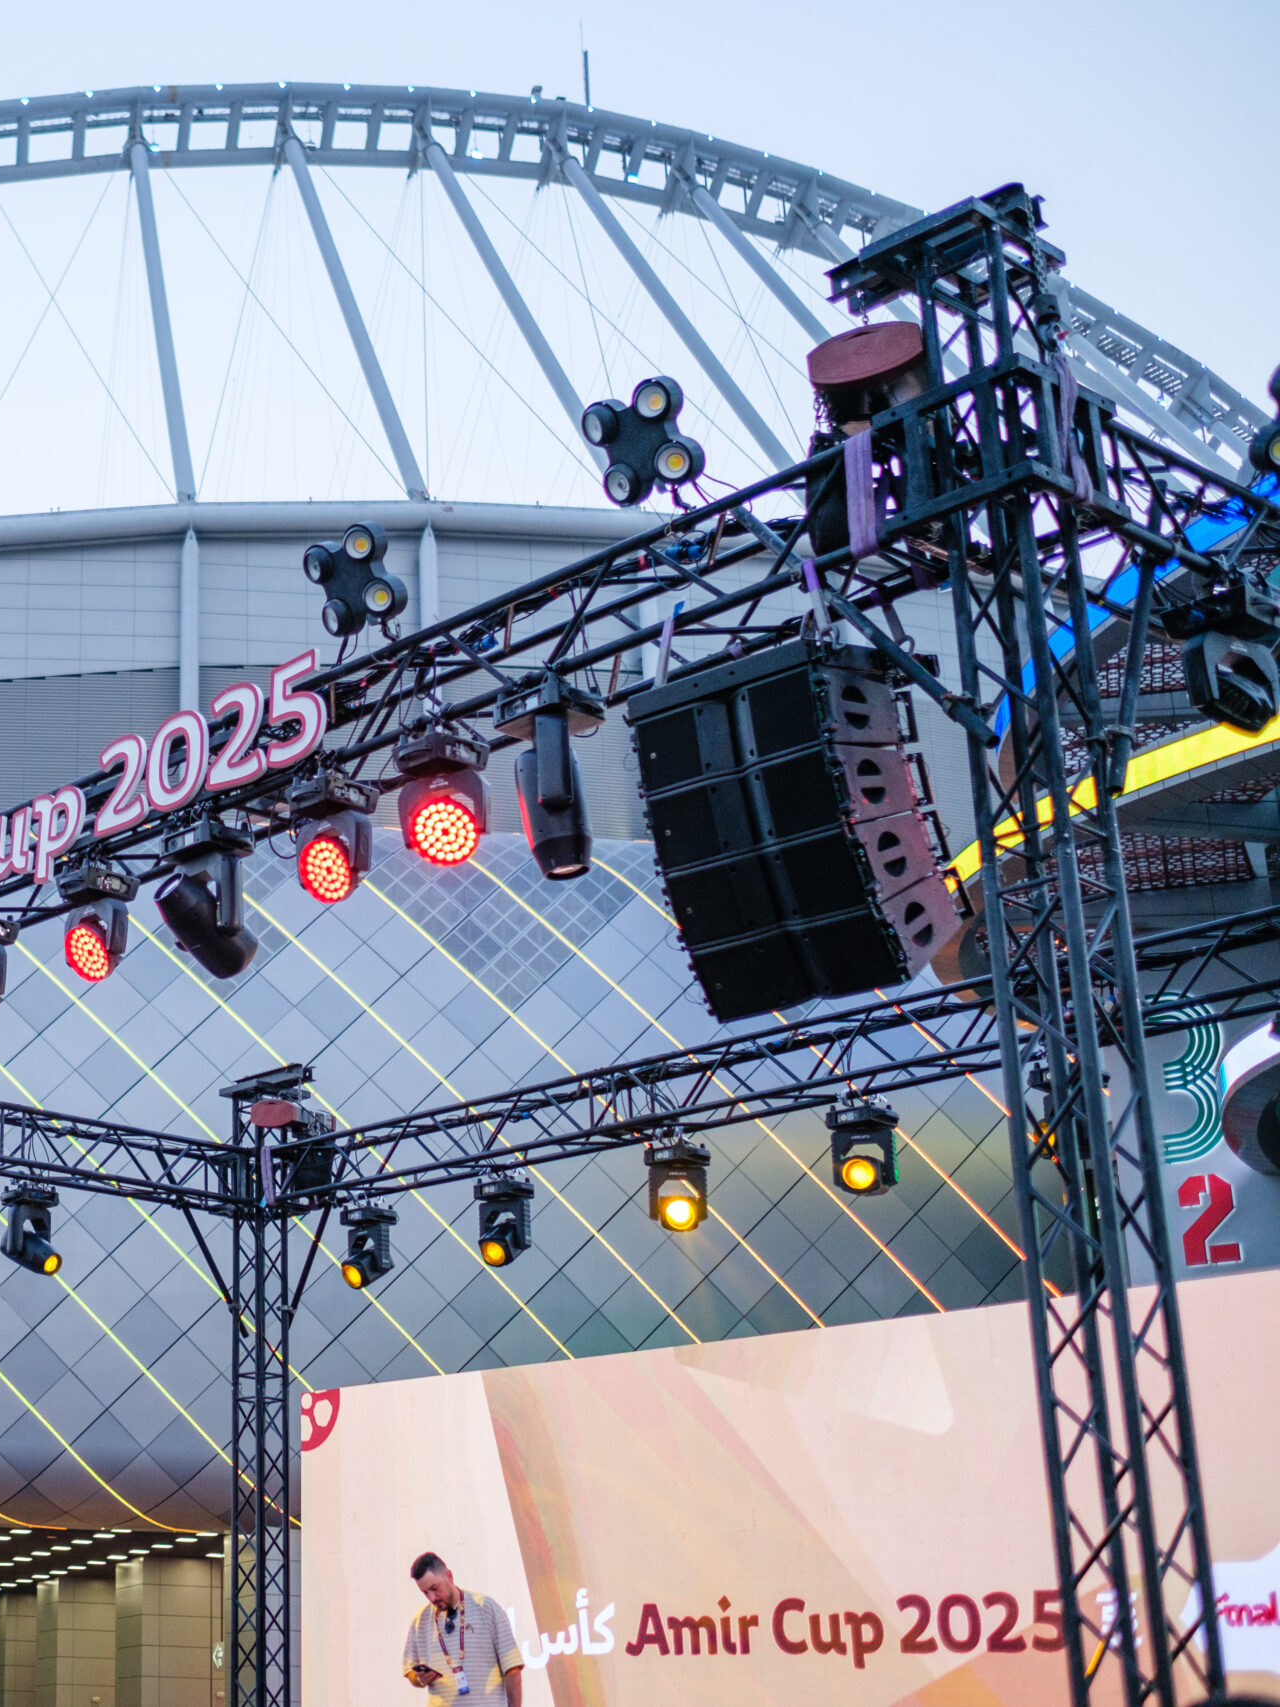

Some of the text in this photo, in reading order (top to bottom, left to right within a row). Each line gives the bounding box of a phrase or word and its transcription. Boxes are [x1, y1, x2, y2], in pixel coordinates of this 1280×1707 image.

[93, 648, 328, 838] 2025
[1177, 1173, 1241, 1266] 2
[521, 1587, 615, 1670] كأس
[624, 1594, 759, 1657] Amir
[771, 1597, 884, 1669] Cup
[896, 1589, 1068, 1654] 2025
